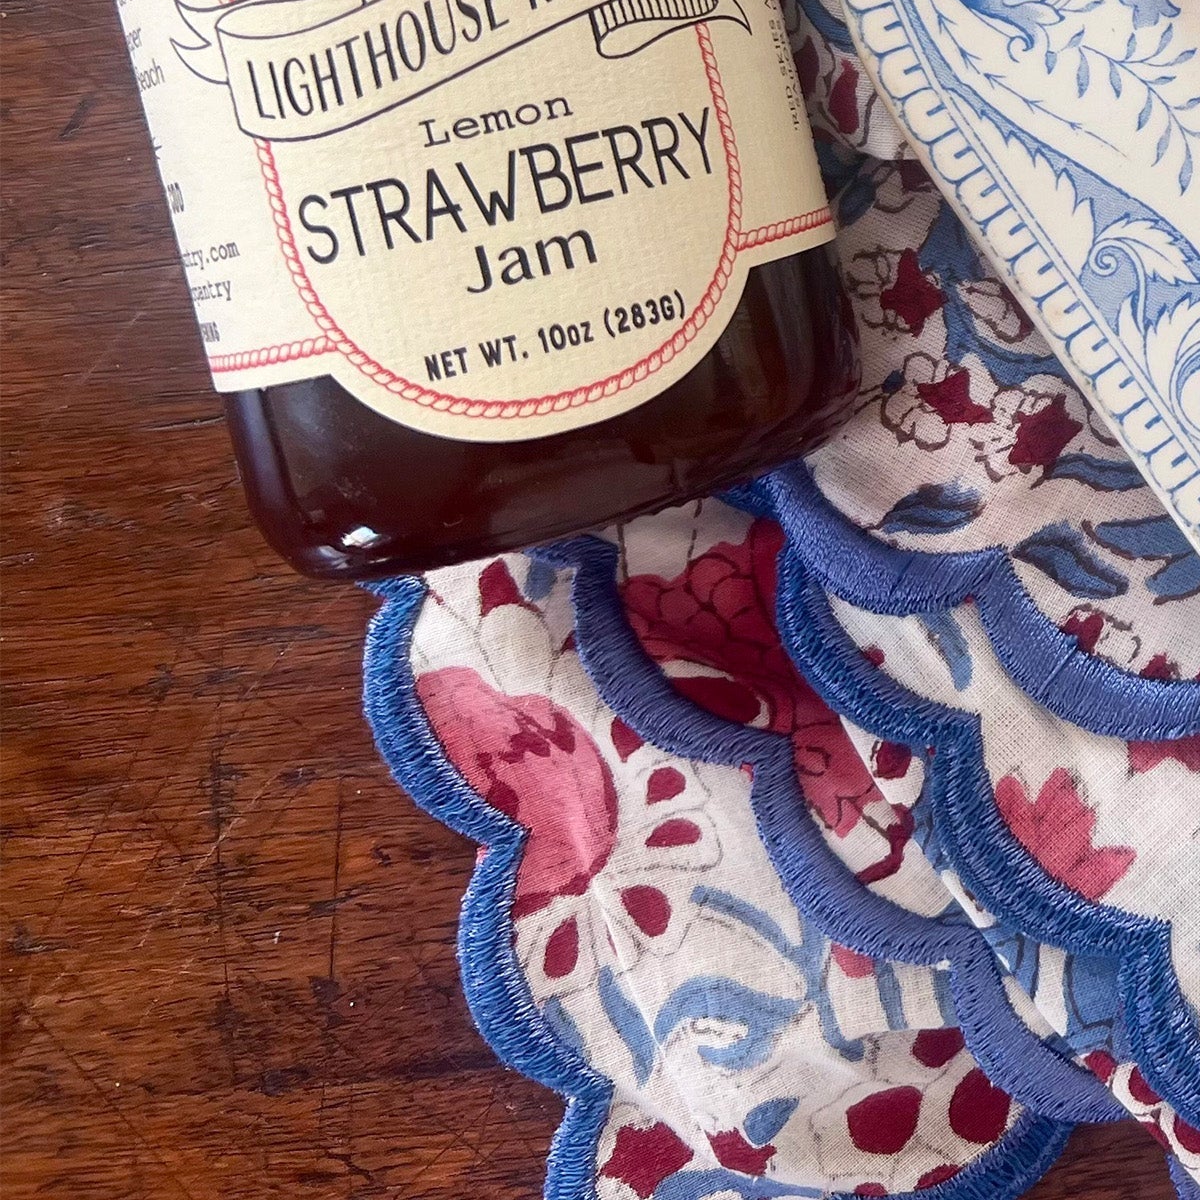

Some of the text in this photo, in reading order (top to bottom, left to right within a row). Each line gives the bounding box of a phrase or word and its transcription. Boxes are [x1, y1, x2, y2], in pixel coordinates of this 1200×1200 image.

[417, 96, 574, 149] Lemon
[298, 106, 716, 265] STRAWBERRY
[466, 228, 599, 295] Jam
[424, 347, 468, 382] NET
[477, 336, 529, 370] WT.
[603, 289, 686, 339] (283G)
